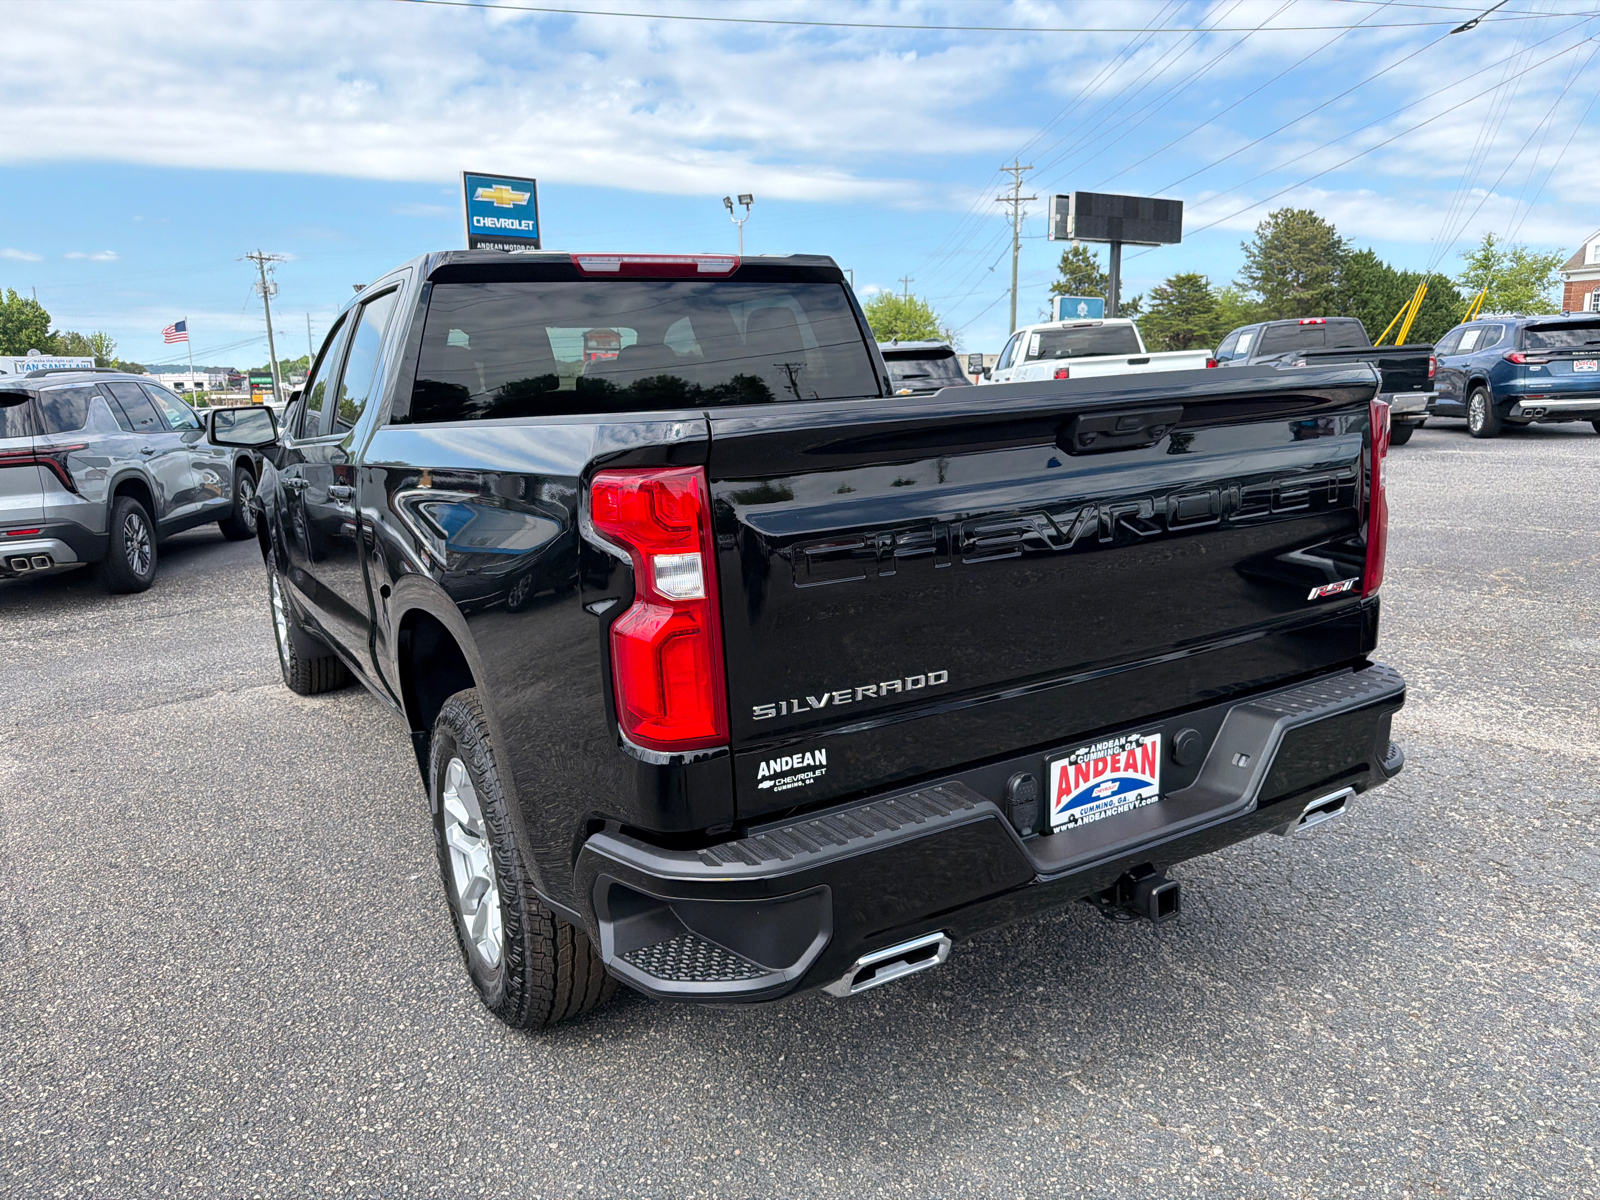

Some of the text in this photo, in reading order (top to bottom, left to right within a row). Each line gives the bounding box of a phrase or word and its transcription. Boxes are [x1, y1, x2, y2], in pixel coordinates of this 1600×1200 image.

[473, 216, 534, 230] CHEVROLET
[477, 242, 503, 250] ANDEAN
[791, 466, 1353, 589] CHEVROLET
[1307, 577, 1359, 600] RST
[752, 670, 949, 721] SILVERADO
[1077, 742, 1137, 764] CUMMING, GA
[1089, 737, 1126, 753] ANDEAN
[757, 748, 827, 780] ANDEAN
[1055, 740, 1157, 809] ANDEAN
[773, 781, 804, 792] CUMMING,
[775, 768, 827, 786] CHEVROLET
[1053, 795, 1159, 834] www.ANDEANCHEVY.com
[1080, 800, 1116, 816] CUMMING,
